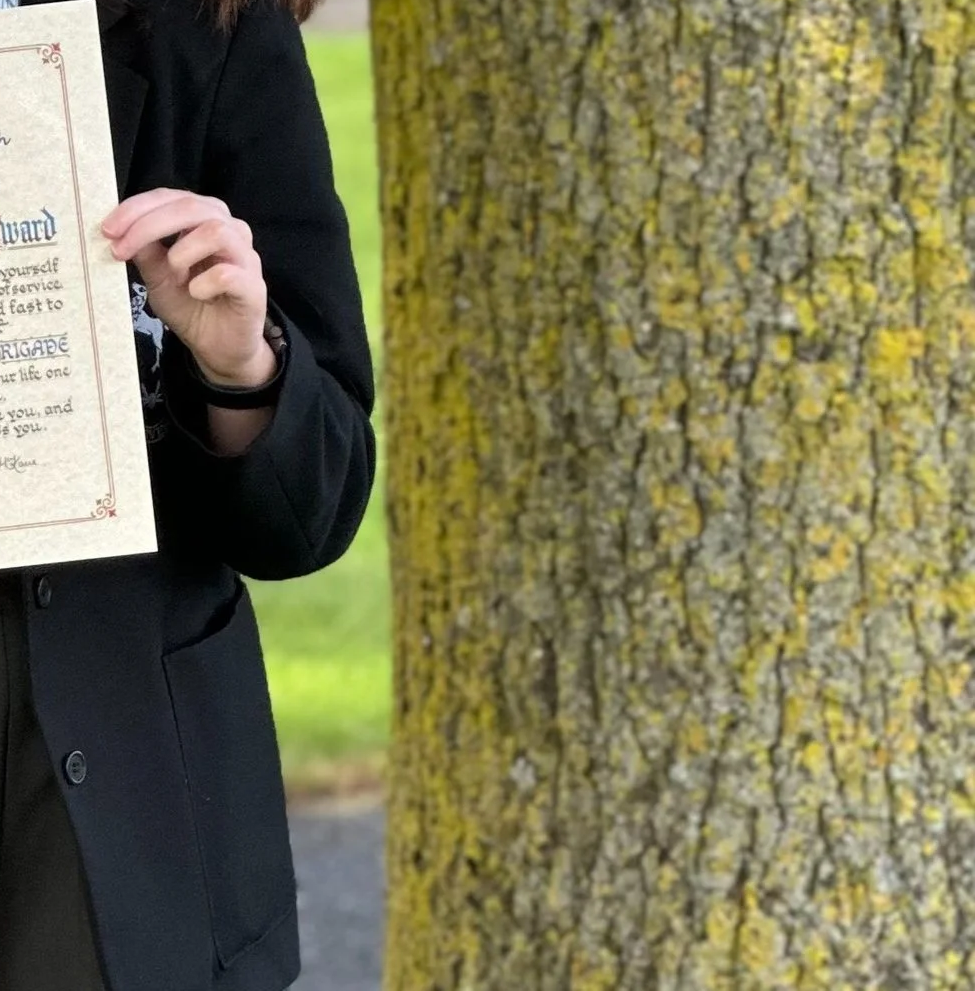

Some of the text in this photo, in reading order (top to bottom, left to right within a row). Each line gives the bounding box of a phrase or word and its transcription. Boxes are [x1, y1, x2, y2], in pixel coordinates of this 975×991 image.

[9, 299, 43, 315] fast
[46, 297, 64, 310] to
[19, 365, 42, 382] life
[45, 367, 71, 379] one
[44, 397, 74, 416] and
